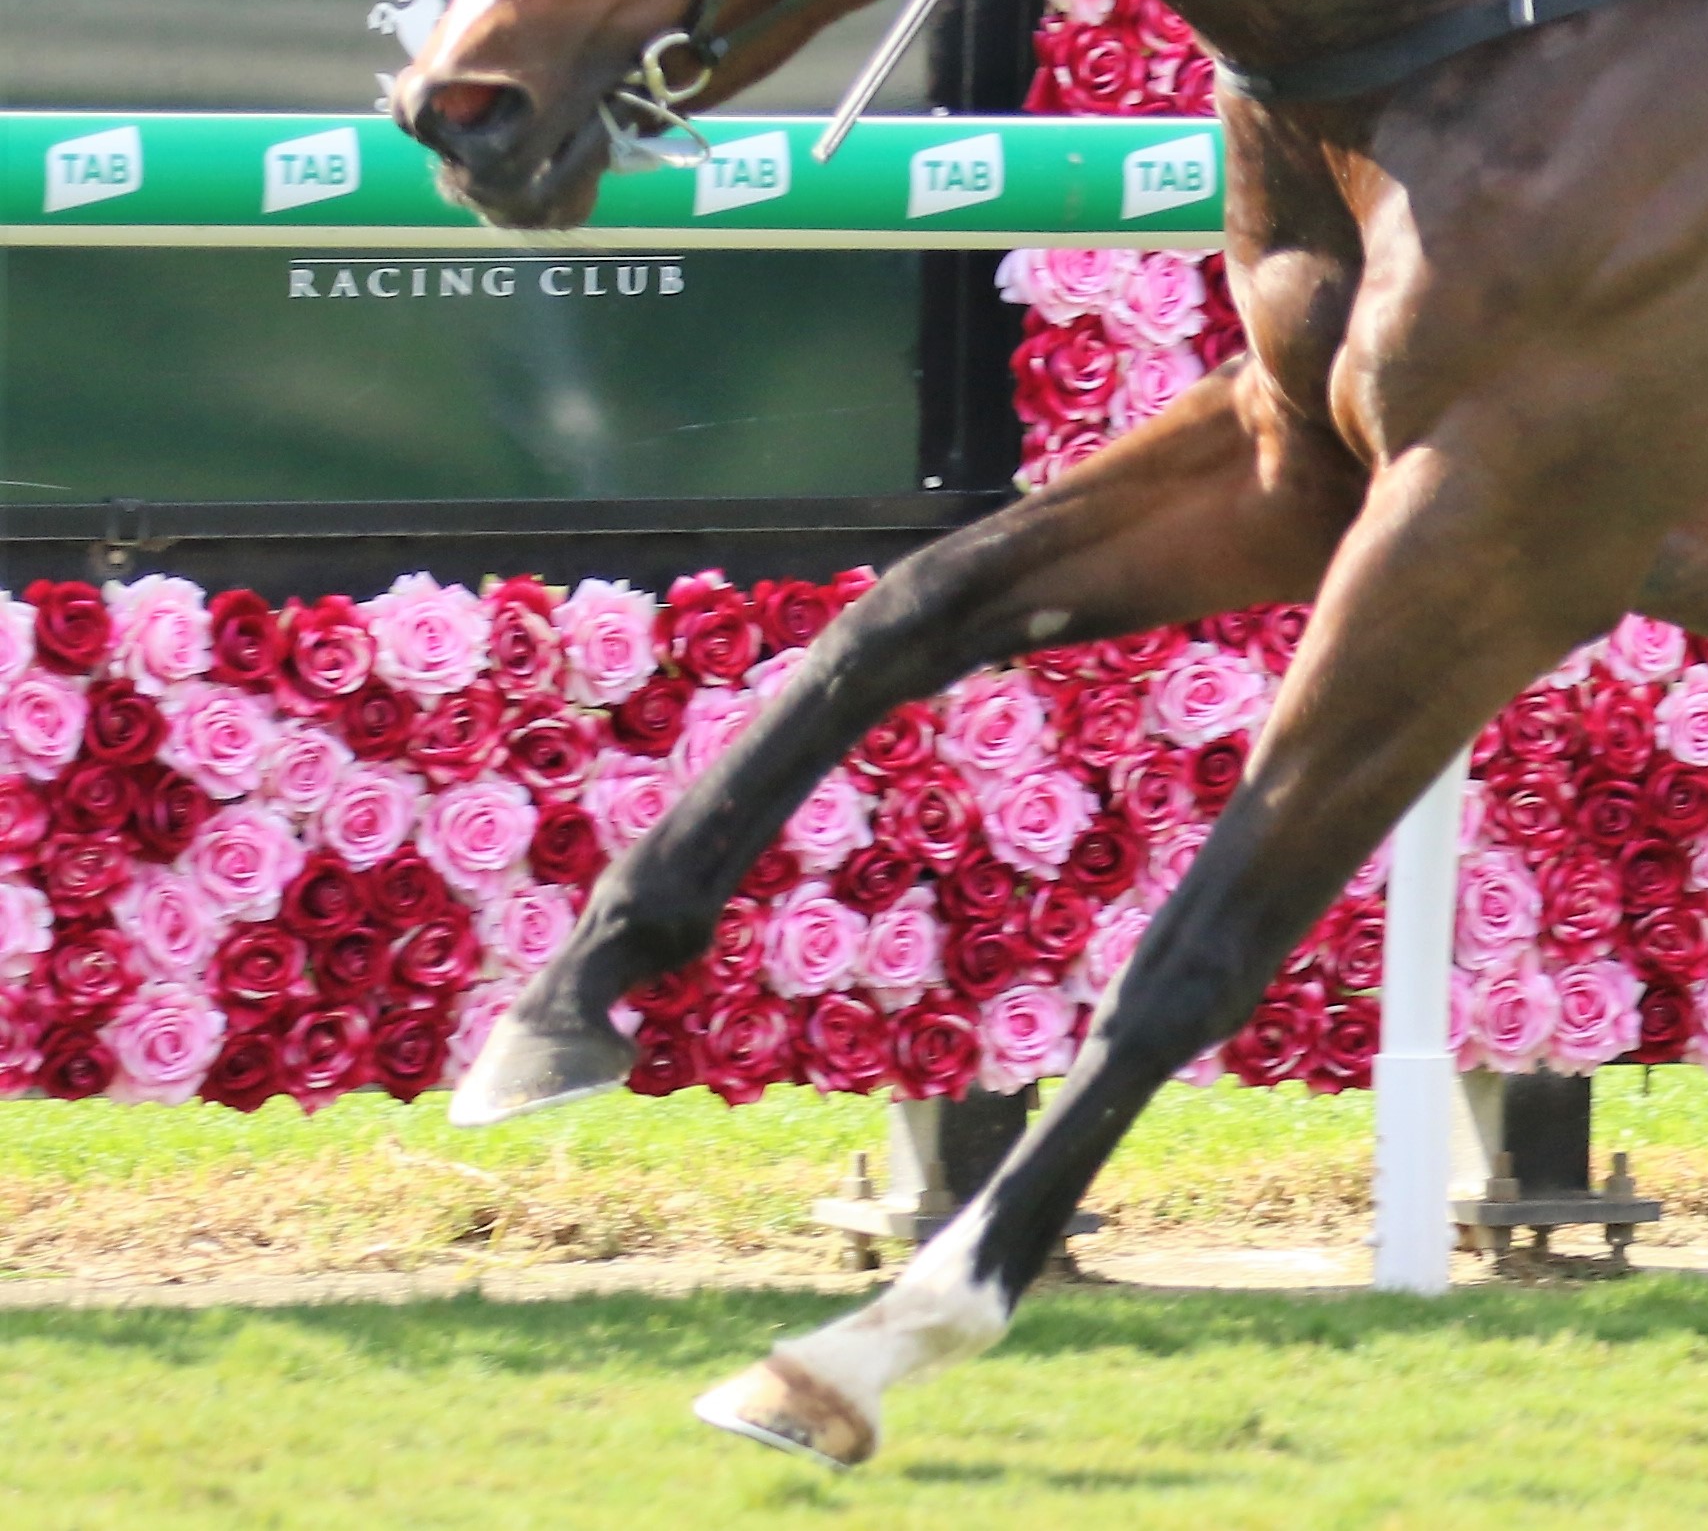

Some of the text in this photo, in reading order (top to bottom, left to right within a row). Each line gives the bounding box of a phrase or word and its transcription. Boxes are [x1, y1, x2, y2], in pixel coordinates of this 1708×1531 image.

[59, 153, 130, 185] TAB
[277, 154, 347, 185] TAB
[709, 157, 778, 189] TAB
[923, 160, 992, 192] TAB
[1135, 160, 1203, 192] TAB
[287, 265, 686, 299] RACING CLUB
